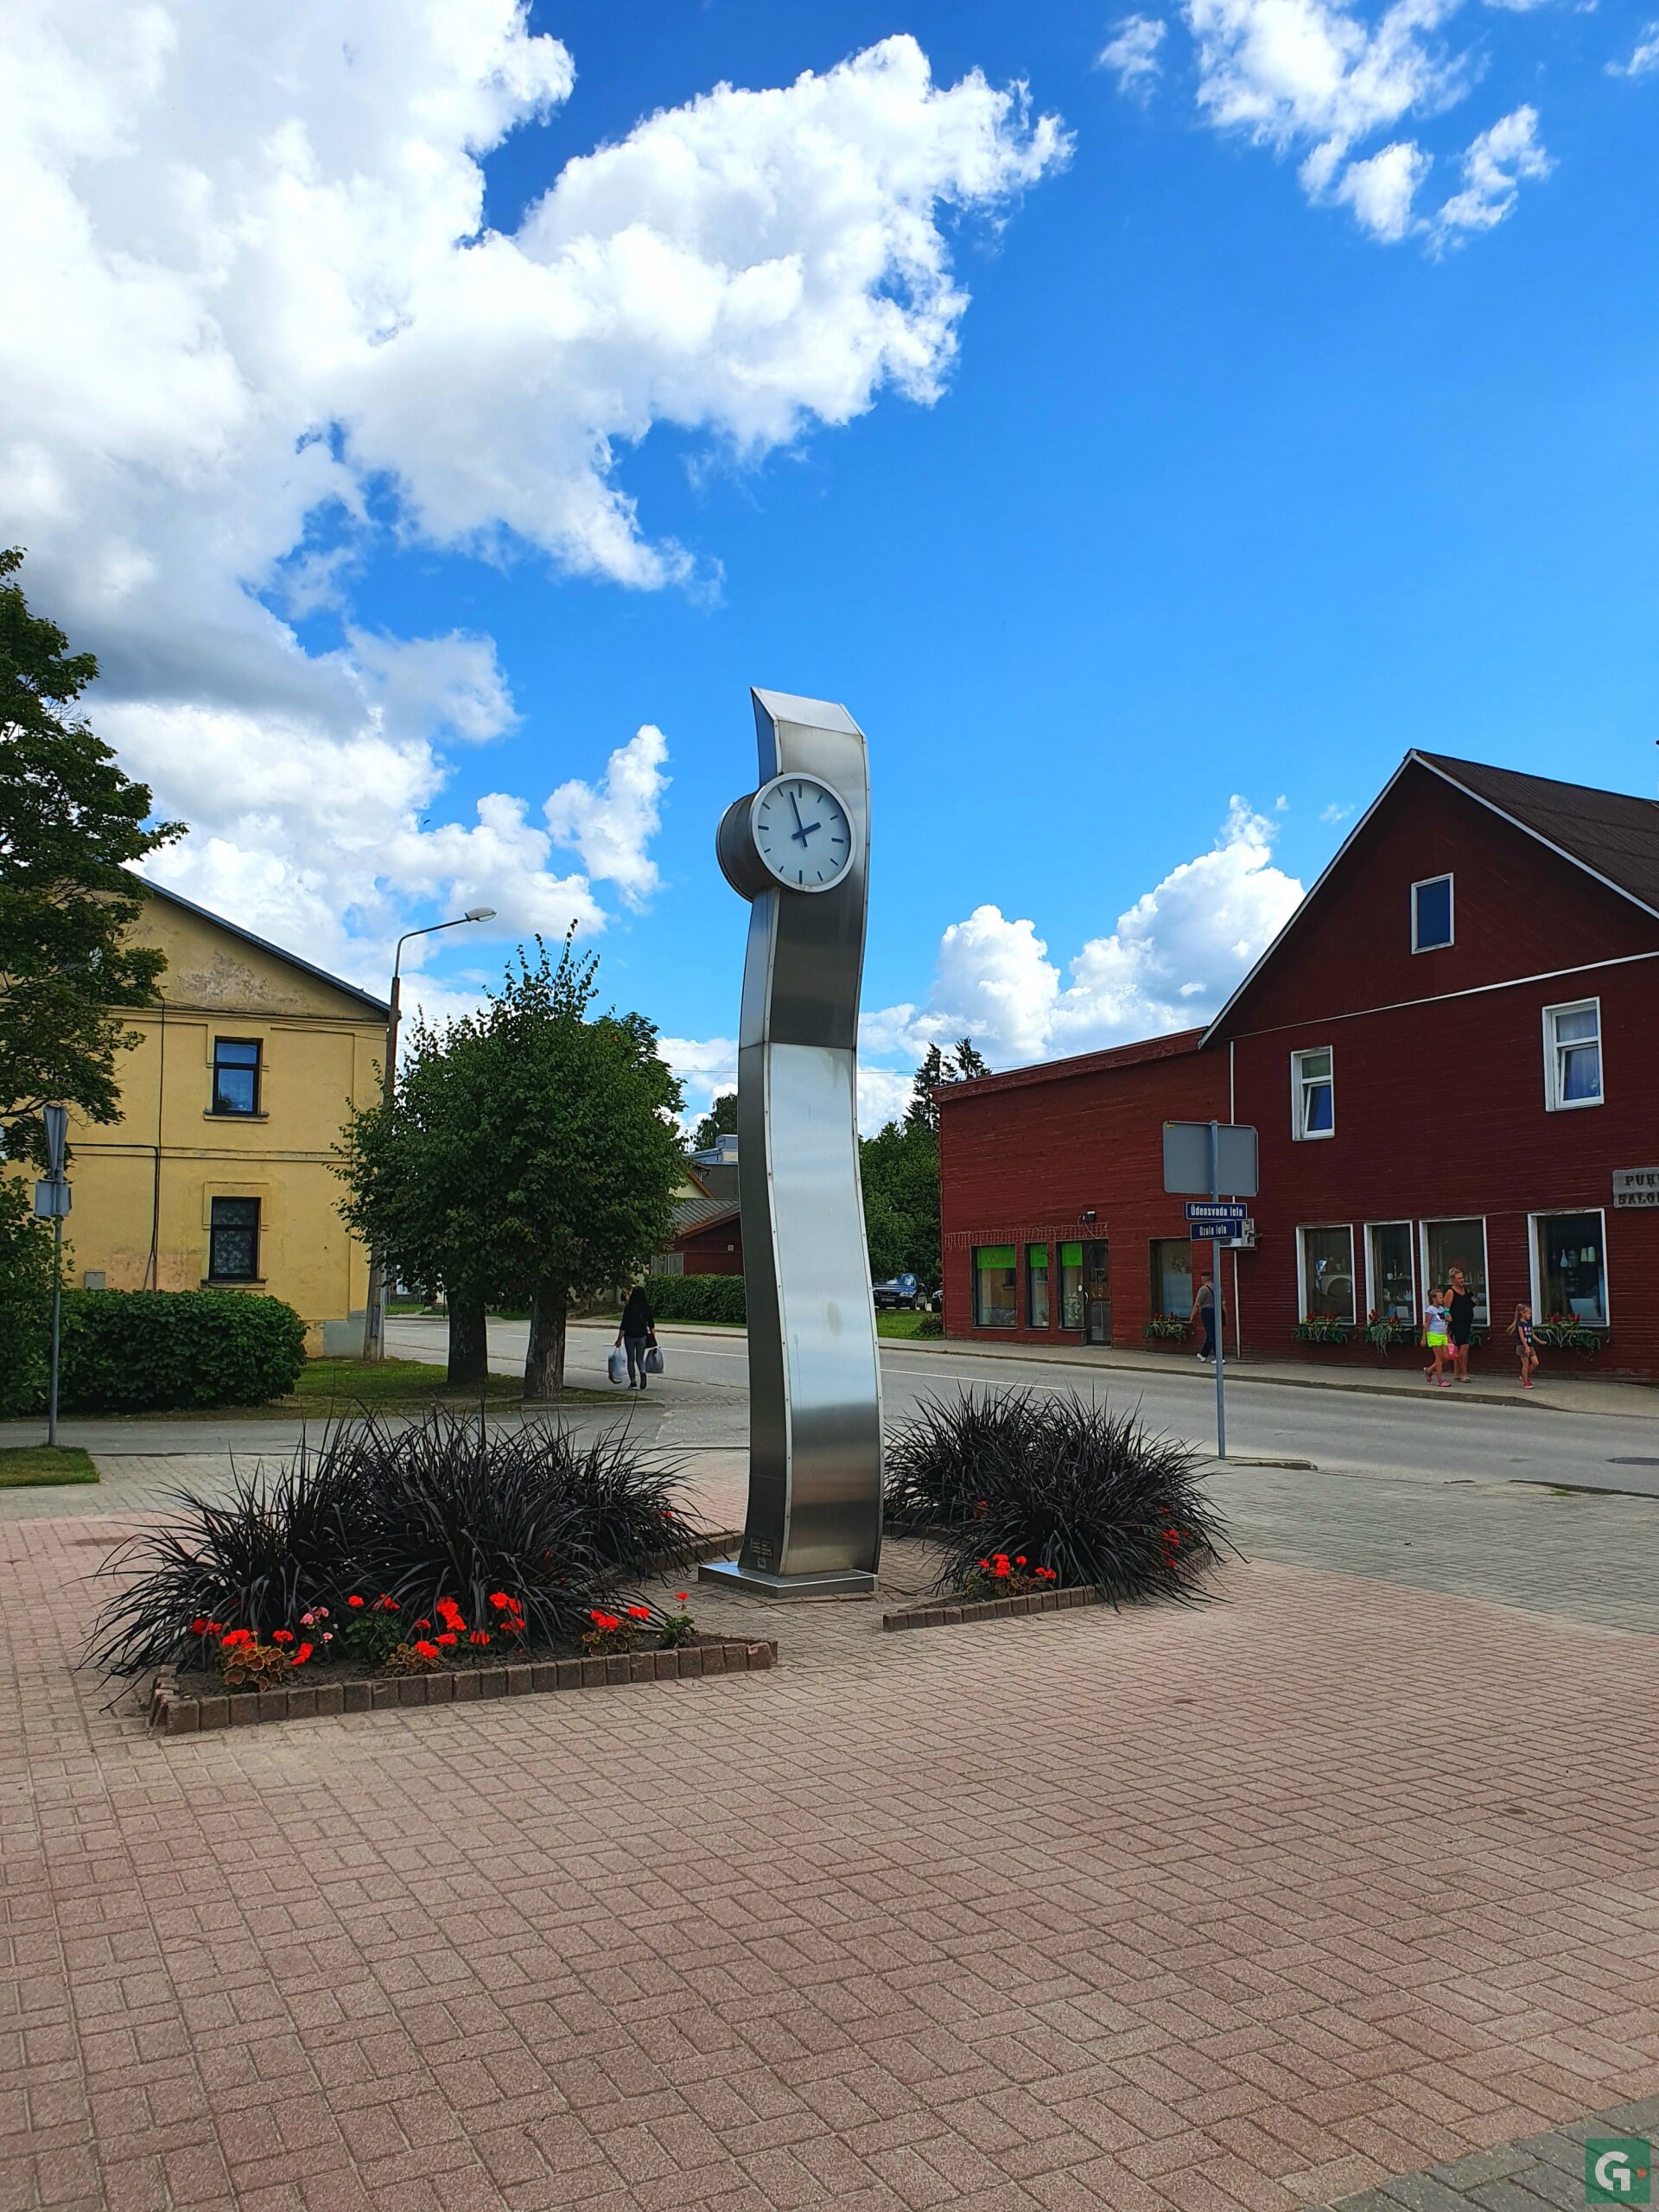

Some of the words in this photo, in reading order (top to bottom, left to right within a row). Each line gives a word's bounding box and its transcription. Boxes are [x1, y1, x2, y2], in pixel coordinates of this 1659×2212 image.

[1625, 1173, 1659, 1187] PUĶ
[1618, 1192, 1659, 1205] SALO
[1191, 1204, 1228, 1217] Ūdensvada
[1230, 1206, 1243, 1217] iela
